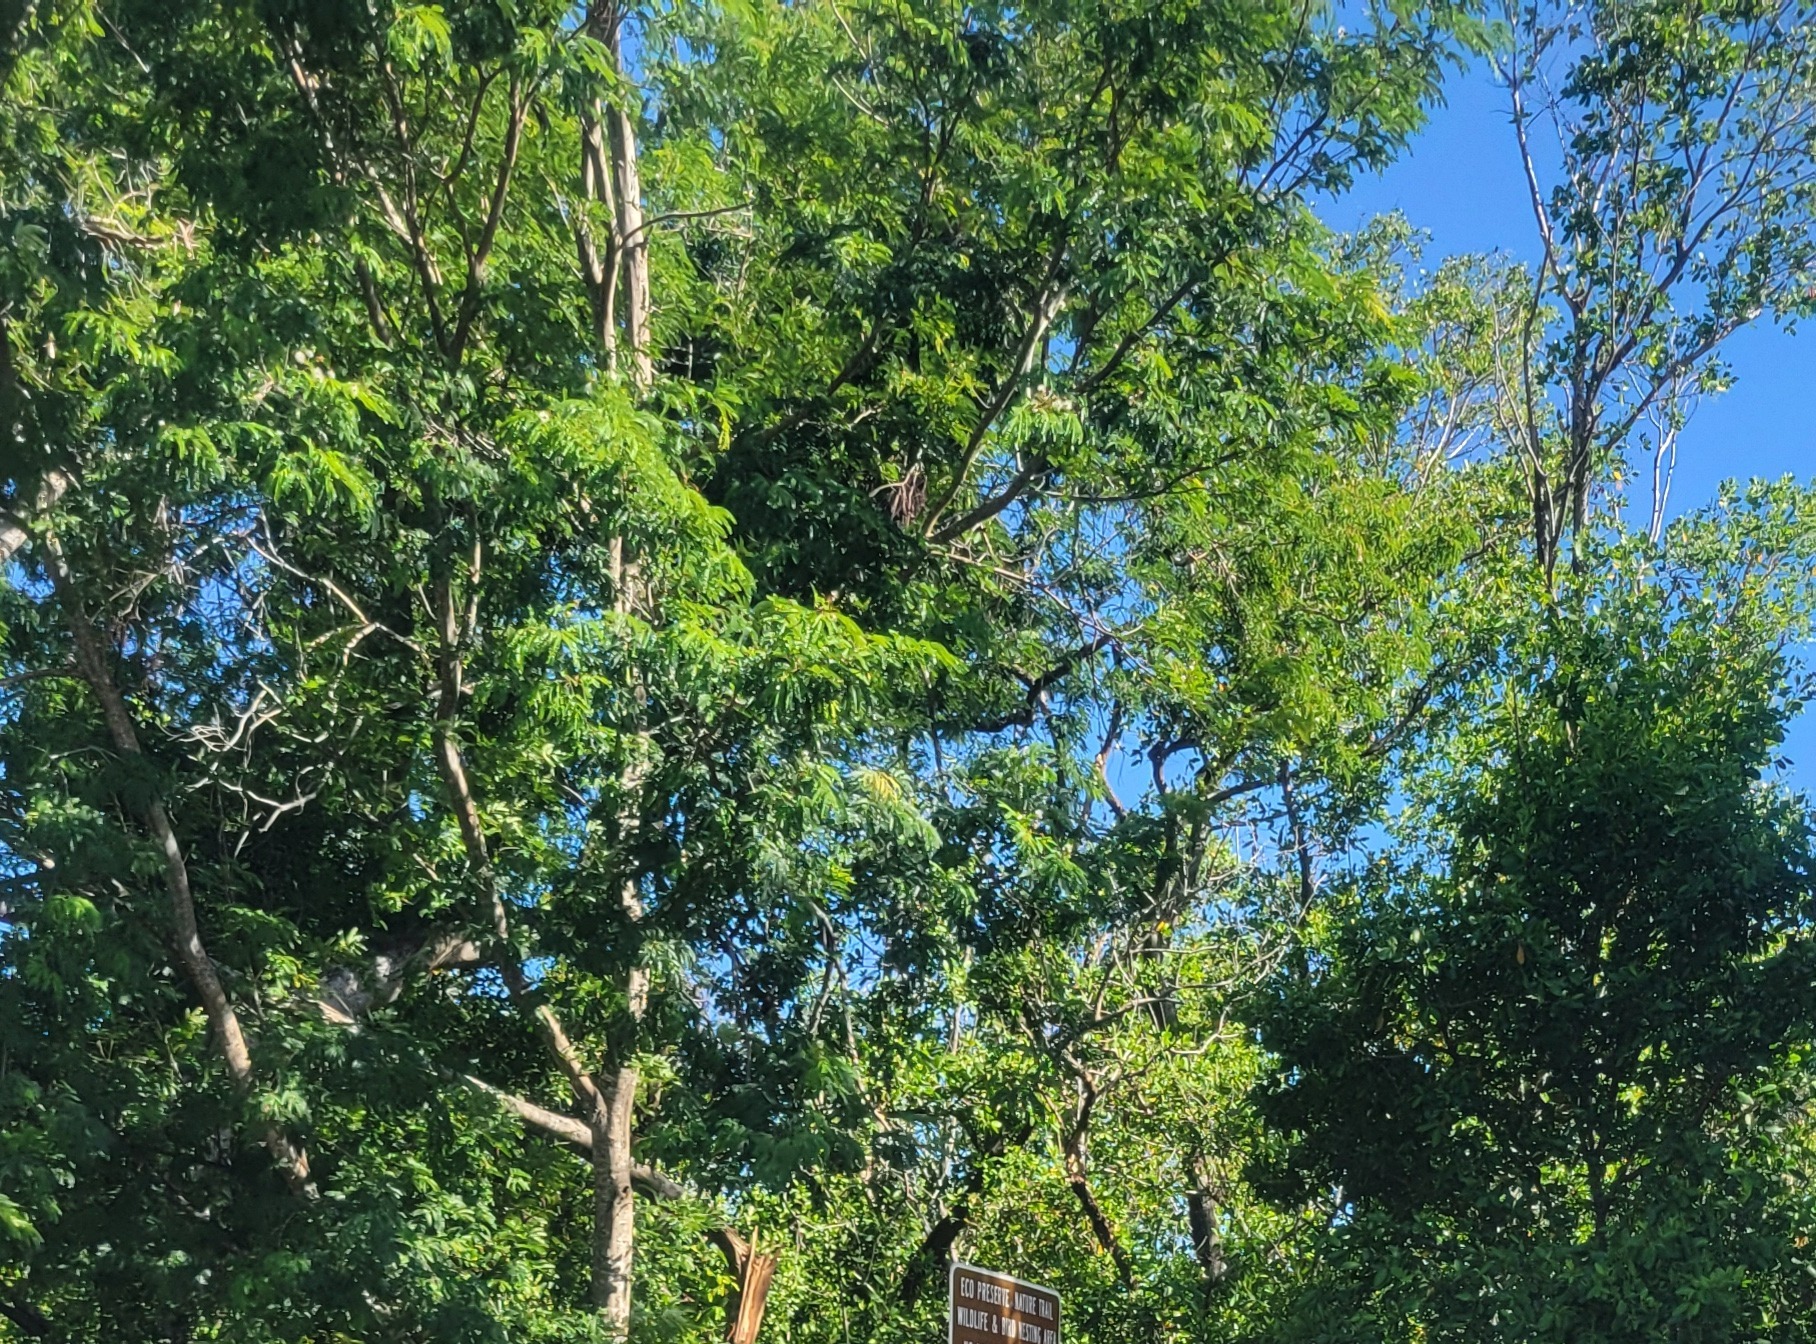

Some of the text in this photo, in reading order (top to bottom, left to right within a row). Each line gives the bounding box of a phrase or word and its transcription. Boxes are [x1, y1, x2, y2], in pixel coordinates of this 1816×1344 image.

[961, 1277, 1053, 1320] ECO PRESERVE NATURE TRAIL
[957, 1306, 988, 1331] WILDLIFE
[992, 1314, 998, 1334] &
[1001, 1317, 1016, 1338] BIRD
[1018, 1321, 1041, 1344] NESTING
